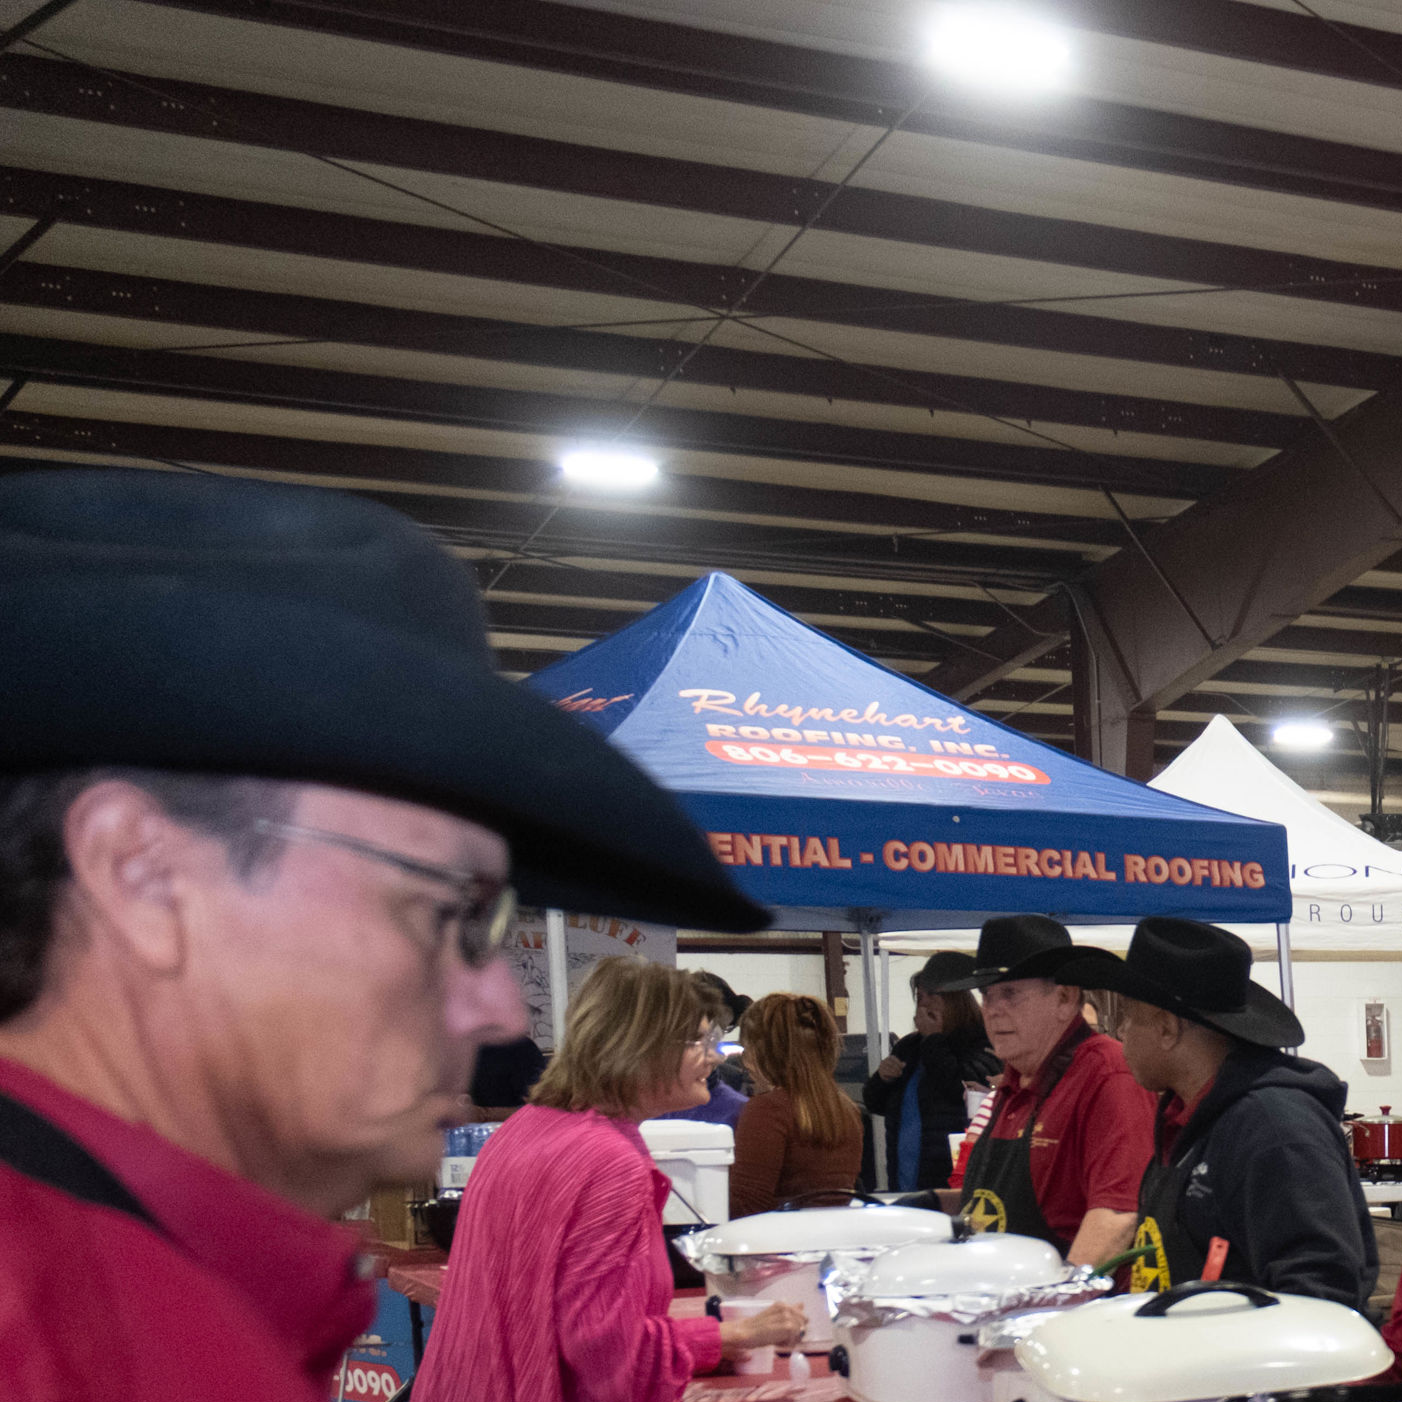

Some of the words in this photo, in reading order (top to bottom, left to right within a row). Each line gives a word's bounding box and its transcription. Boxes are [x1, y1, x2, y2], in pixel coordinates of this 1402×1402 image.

[721, 743, 1037, 782] 806-622-0090
[929, 739, 1011, 759] INC.
[882, 840, 1116, 882] COMMERCIAL
[1124, 853, 1266, 889] ROOFING
